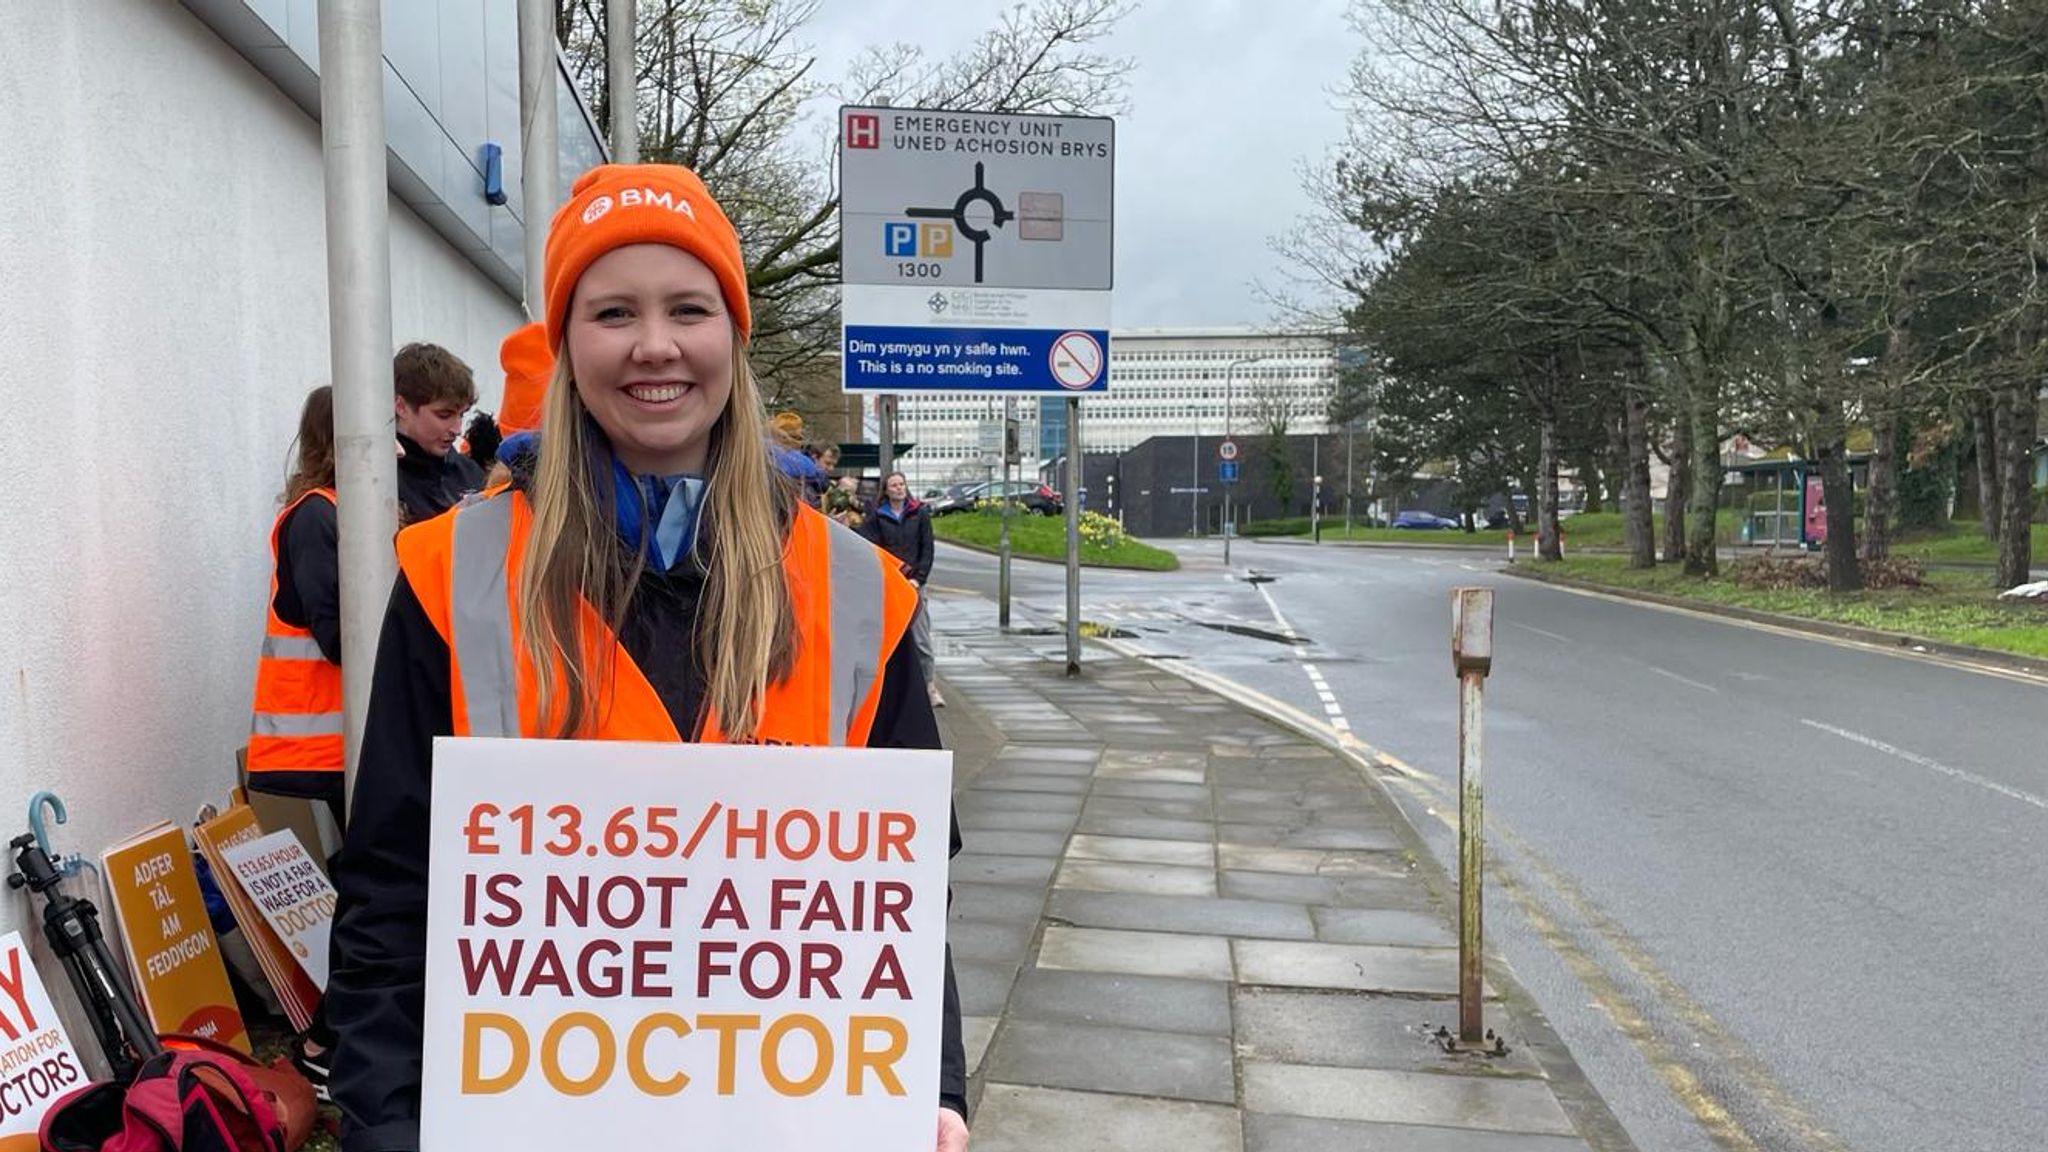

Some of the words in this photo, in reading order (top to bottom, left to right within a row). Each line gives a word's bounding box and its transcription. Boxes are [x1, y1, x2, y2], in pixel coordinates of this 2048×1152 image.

[851, 117, 875, 146] H
[894, 116, 1011, 136] EMERGENCY
[1020, 122, 1063, 138] UNIT
[894, 136, 945, 151] UNED
[955, 138, 1054, 156] ACHOSION
[1061, 143, 1107, 157] BRYS
[620, 188, 696, 223] BMA
[892, 226, 911, 253] P
[930, 227, 948, 254] P
[898, 263, 942, 278] 1300
[849, 340, 876, 353] Dim
[879, 342, 931, 358] ysmygu
[934, 344, 950, 358] yn
[954, 344, 962, 358] y
[965, 342, 997, 355] safle
[1000, 343, 1031, 356] hwn.
[858, 360, 887, 373] This
[890, 361, 902, 373] is
[905, 364, 914, 374] a
[917, 364, 934, 374] no
[937, 362, 992, 378] smoking
[996, 363, 1023, 375] site.
[463, 801, 917, 863] £13.65/HOUR
[134, 853, 174, 888] ADFER
[250, 881, 265, 896] IS
[262, 871, 287, 891] NOT
[285, 868, 295, 882] A
[292, 861, 316, 879] FAIR
[149, 882, 176, 911] TÂL
[259, 888, 298, 913] WAGE
[293, 880, 319, 900] FOR
[315, 877, 329, 890] A
[463, 873, 523, 927] IS
[544, 875, 688, 929] NOT
[701, 878, 749, 930] A
[770, 879, 913, 932] FAIR
[161, 913, 182, 940] AM
[146, 931, 211, 979] FEDDYGON
[457, 939, 673, 998] WAGE
[697, 941, 842, 999] FOR
[861, 944, 913, 1000] A
[0, 1042, 38, 1078] ATION
[37, 1028, 62, 1055] FOR
[461, 1011, 909, 1098] DOCTOR
[0, 1052, 78, 1124] CTORS
